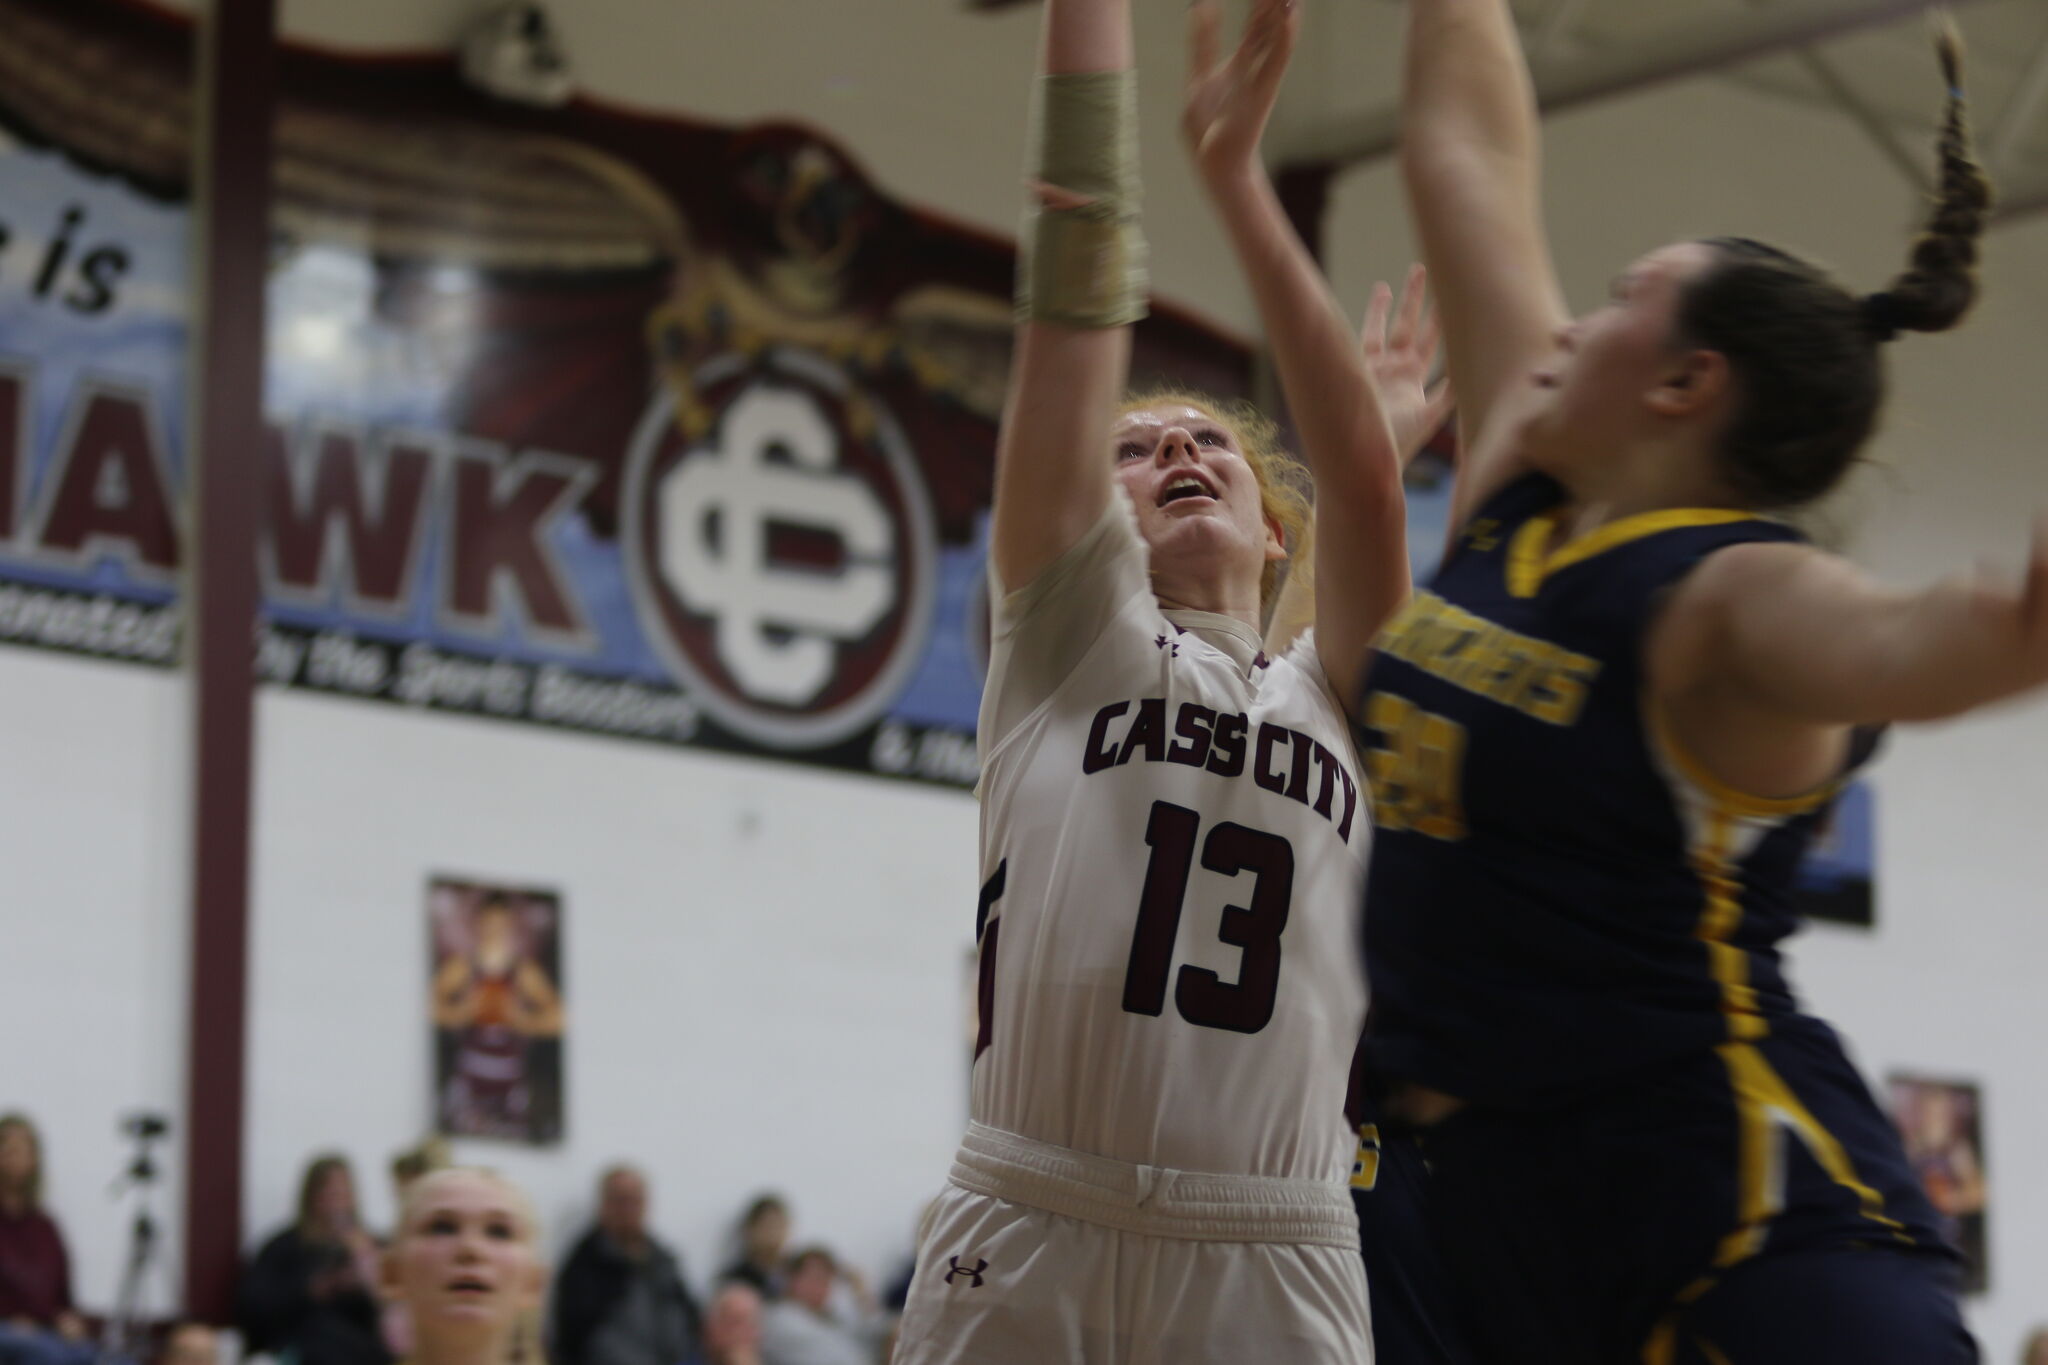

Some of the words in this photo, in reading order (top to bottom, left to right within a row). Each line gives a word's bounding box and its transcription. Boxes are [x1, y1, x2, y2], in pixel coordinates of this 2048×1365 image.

[33, 204, 132, 315] is
[0, 360, 598, 648] AWK
[1082, 698, 1249, 778] CASS
[1253, 720, 1357, 846] CITY
[1121, 799, 1295, 1035] 13
